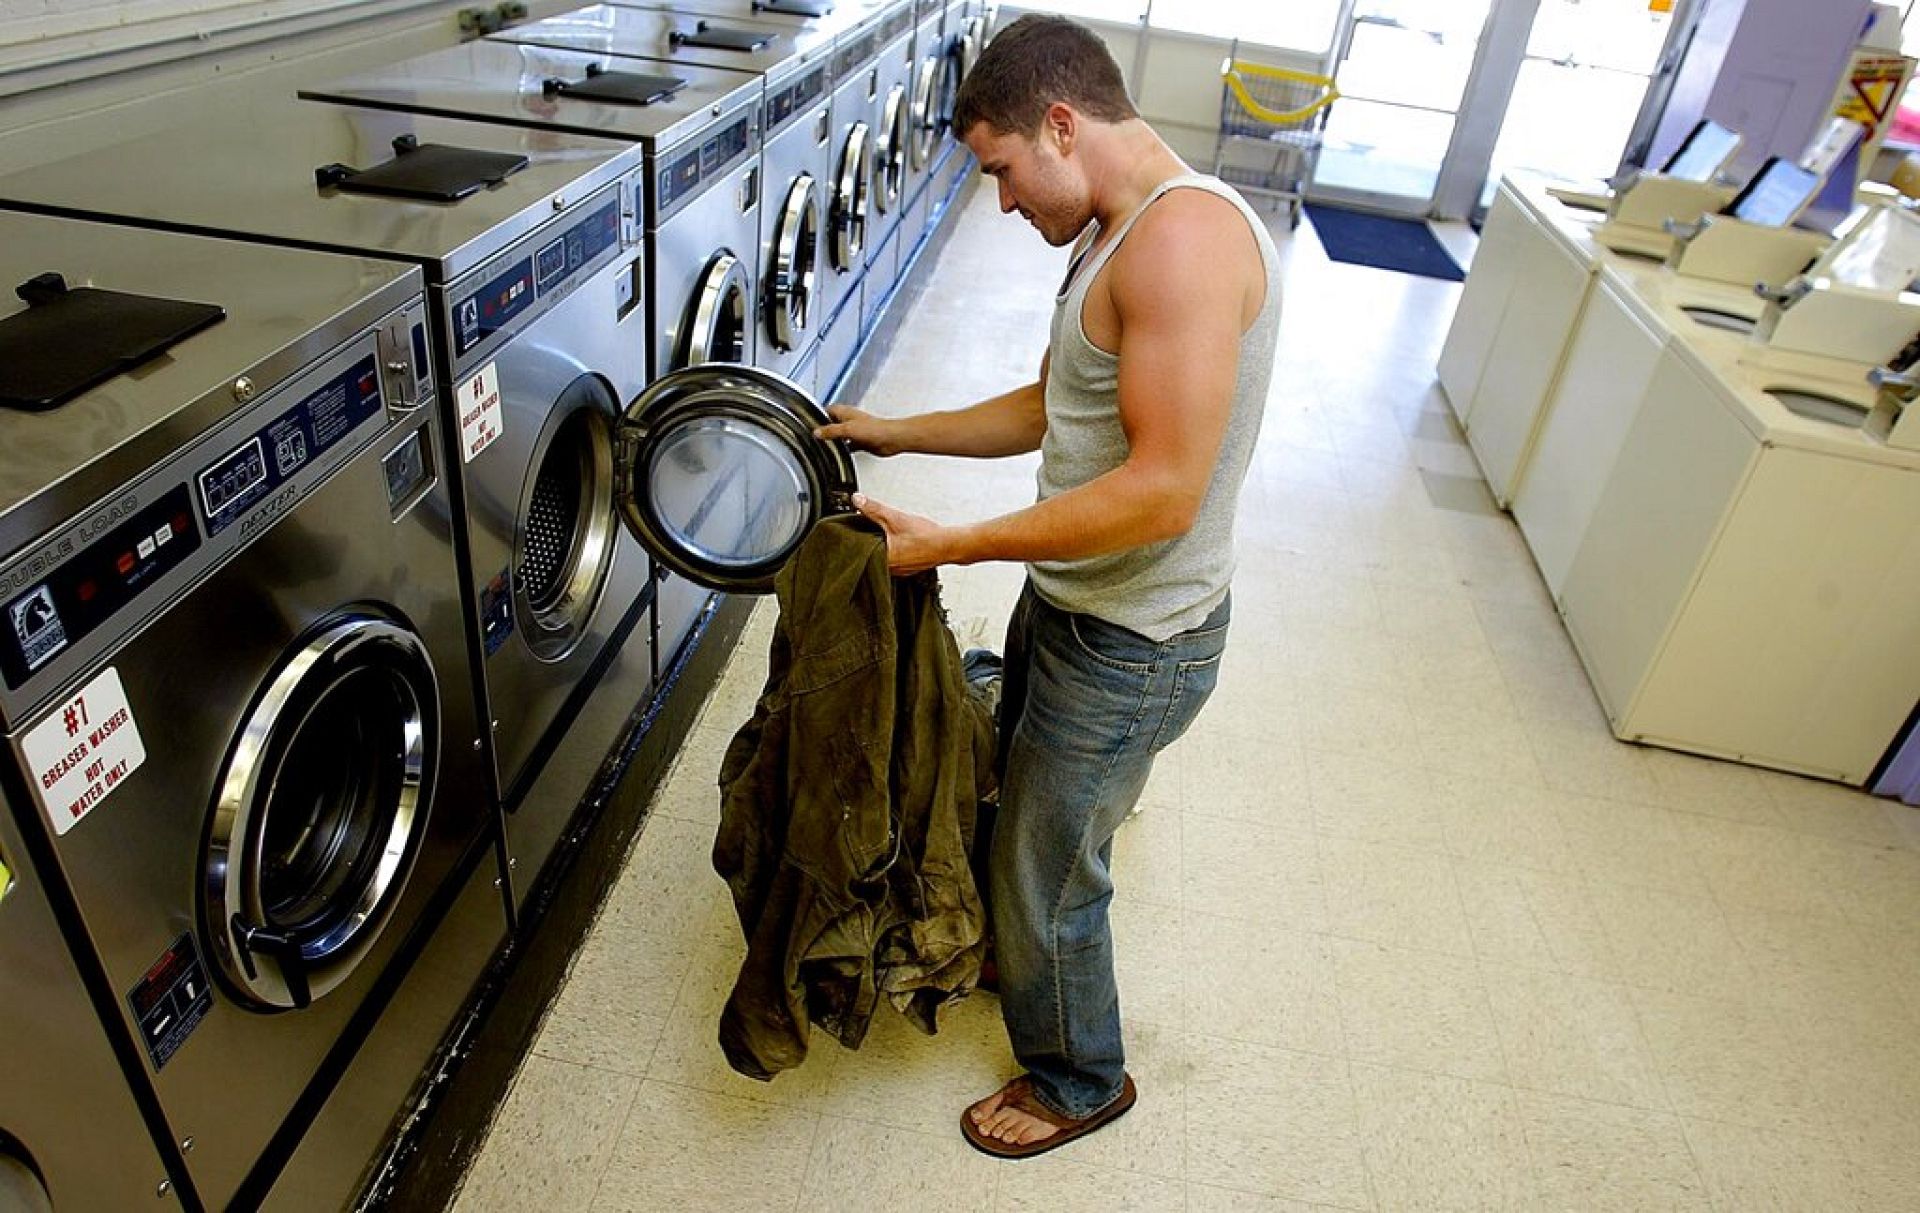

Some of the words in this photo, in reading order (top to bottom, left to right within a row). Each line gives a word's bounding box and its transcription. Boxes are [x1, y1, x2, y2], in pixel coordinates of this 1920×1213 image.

[0, 537, 74, 599] OUBLE
[79, 494, 138, 543] LOAD
[64, 696, 88, 737] #7
[42, 742, 88, 789] GREASER
[88, 708, 129, 748] WASHER
[85, 757, 105, 782] HOT
[69, 781, 104, 818] WATER
[104, 758, 128, 787] ONLY
